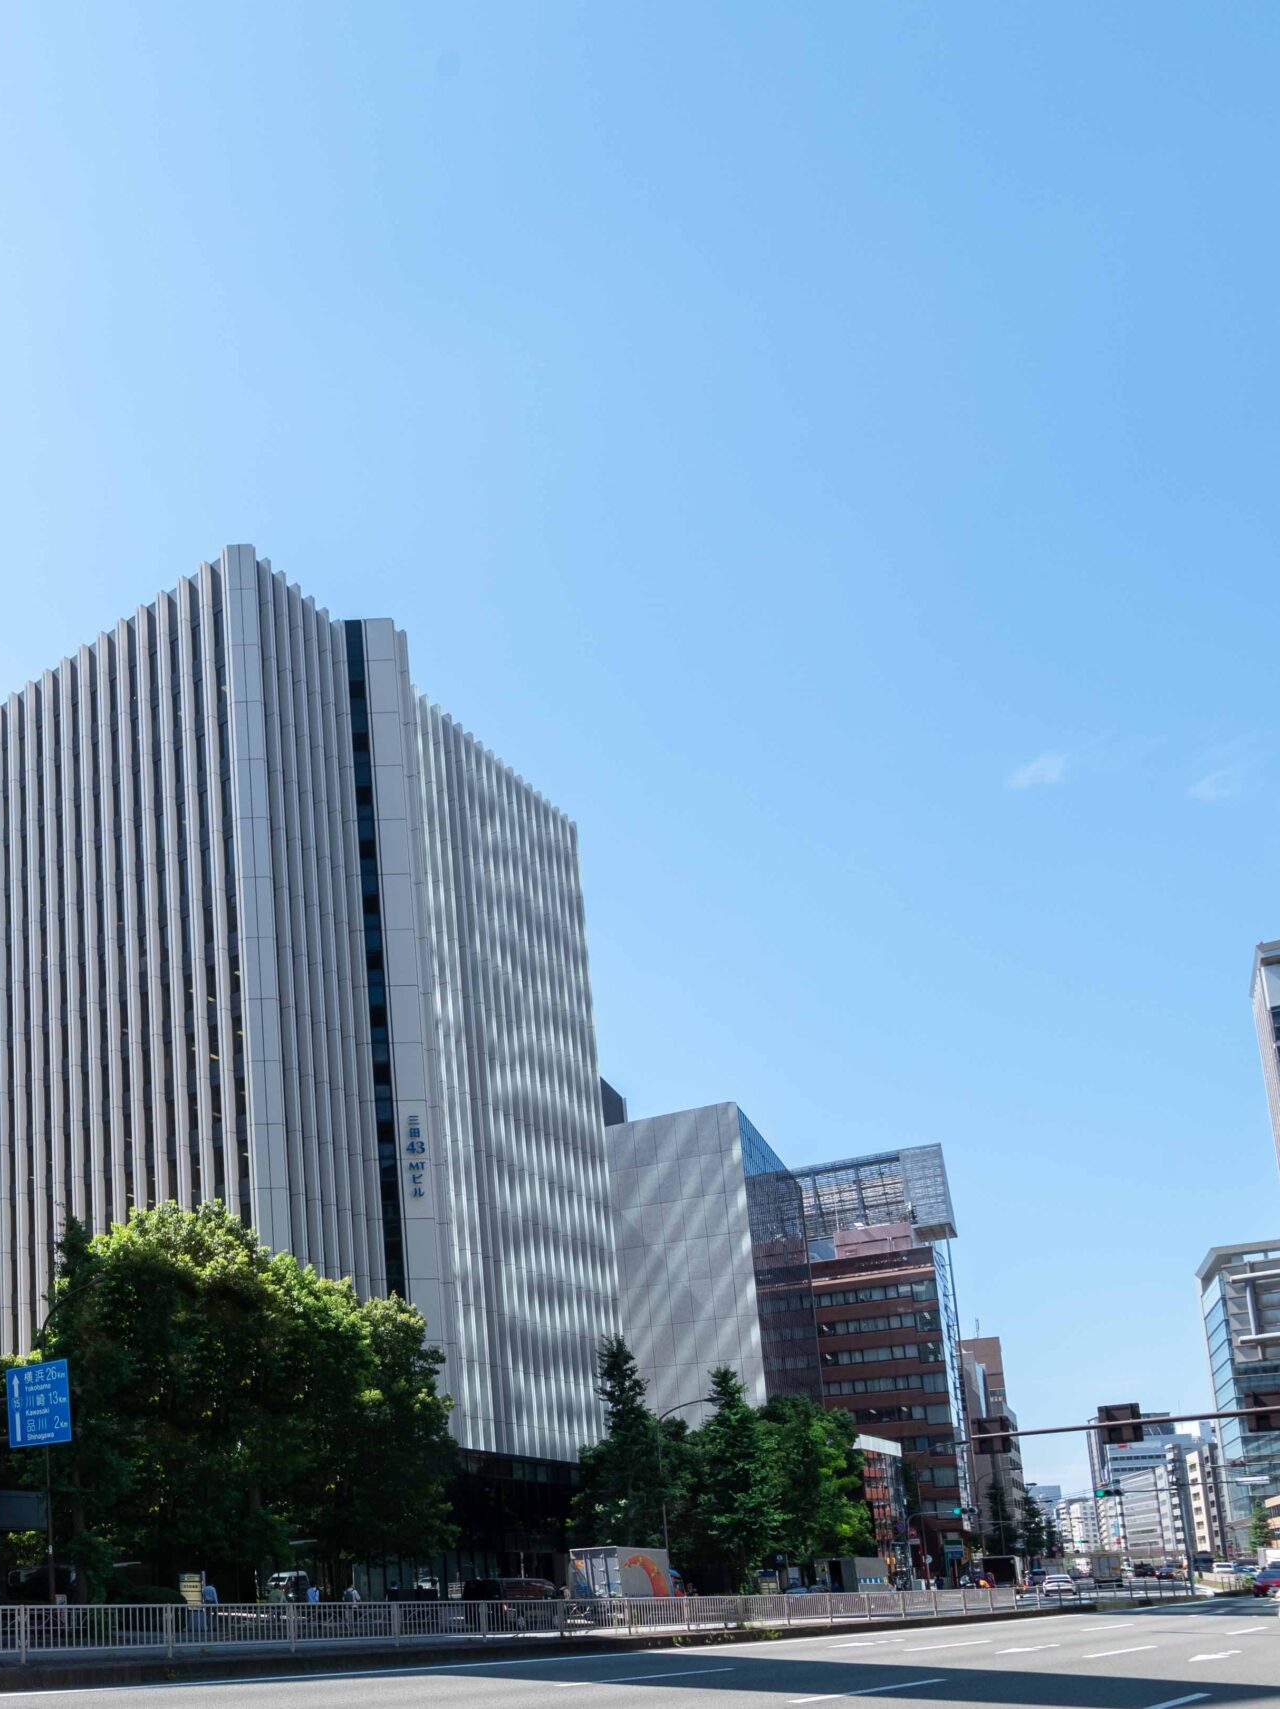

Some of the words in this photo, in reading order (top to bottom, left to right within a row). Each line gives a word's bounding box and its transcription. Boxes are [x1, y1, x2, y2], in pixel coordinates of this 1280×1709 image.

[24, 1369, 44, 1384] 横浜
[24, 1383, 51, 1393] Yokohama
[13, 1399, 21, 1409] 15
[25, 1394, 46, 1408] 川崎
[25, 1407, 50, 1417] Kawasaki
[27, 1418, 48, 1432] 品川
[27, 1431, 55, 1441] Shinagawa
